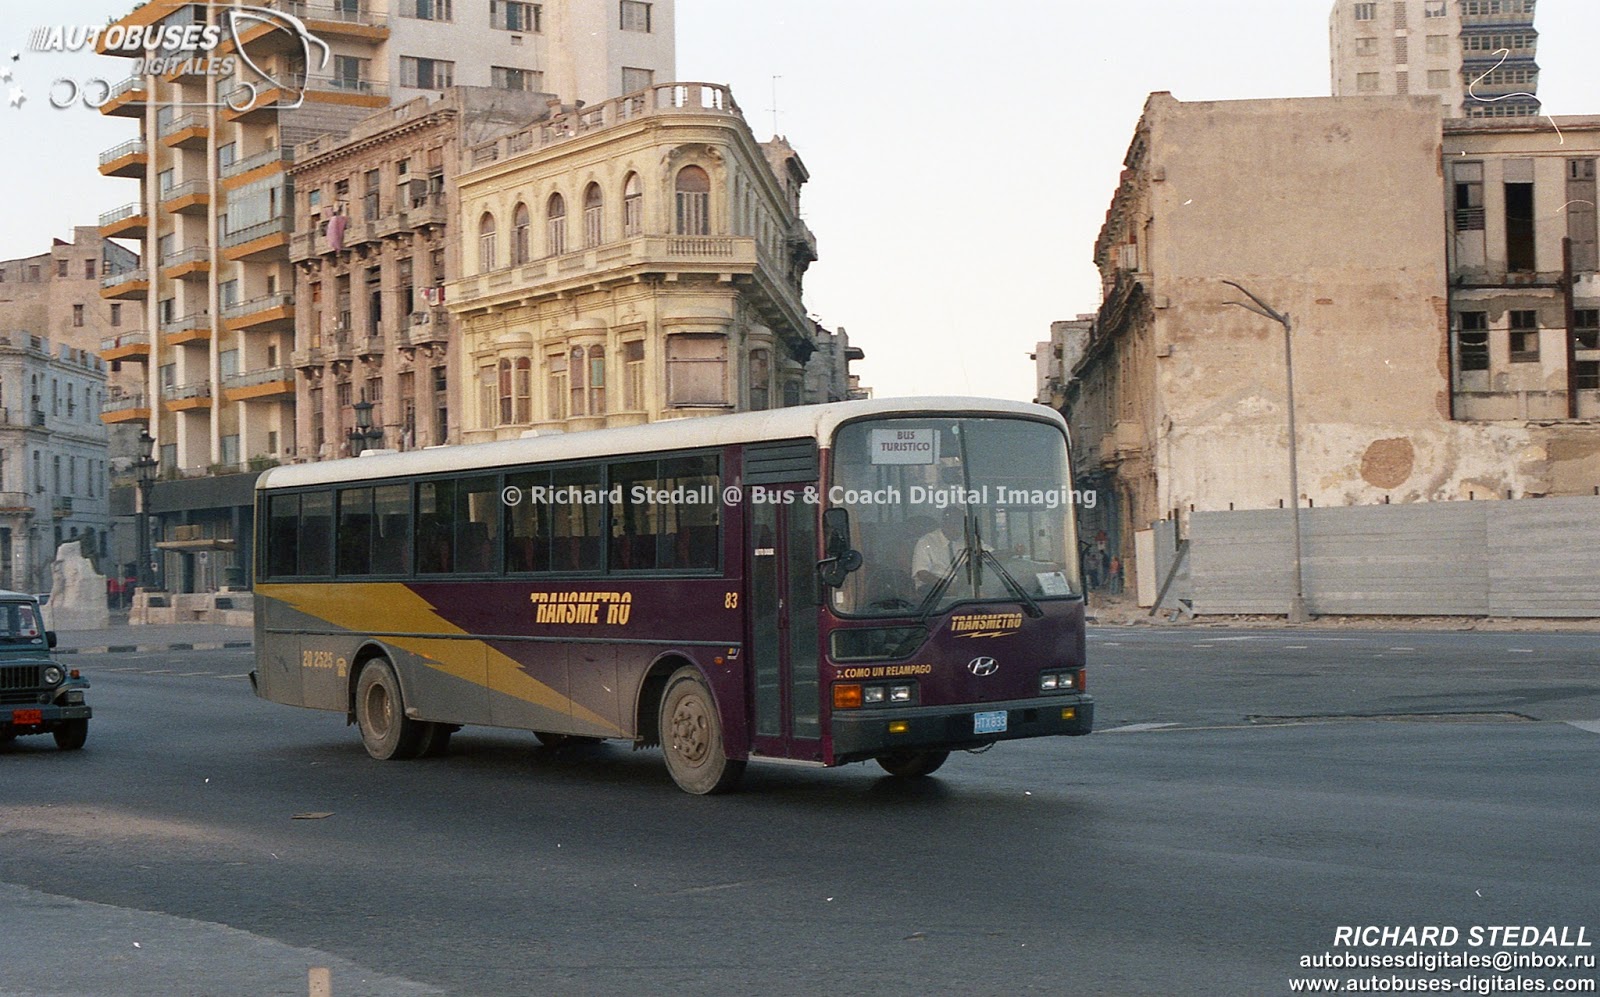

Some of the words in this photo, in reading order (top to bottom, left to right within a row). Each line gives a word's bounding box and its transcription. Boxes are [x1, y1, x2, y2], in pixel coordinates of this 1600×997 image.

[897, 431, 915, 440] BUS
[881, 442, 930, 452] TURISTICO
[530, 591, 633, 625] TRANSMETRO
[724, 592, 739, 609] 83
[951, 612, 1023, 631] TRANSMETRO
[872, 666, 885, 677] UN
[885, 664, 932, 675] RELAMPAGO
